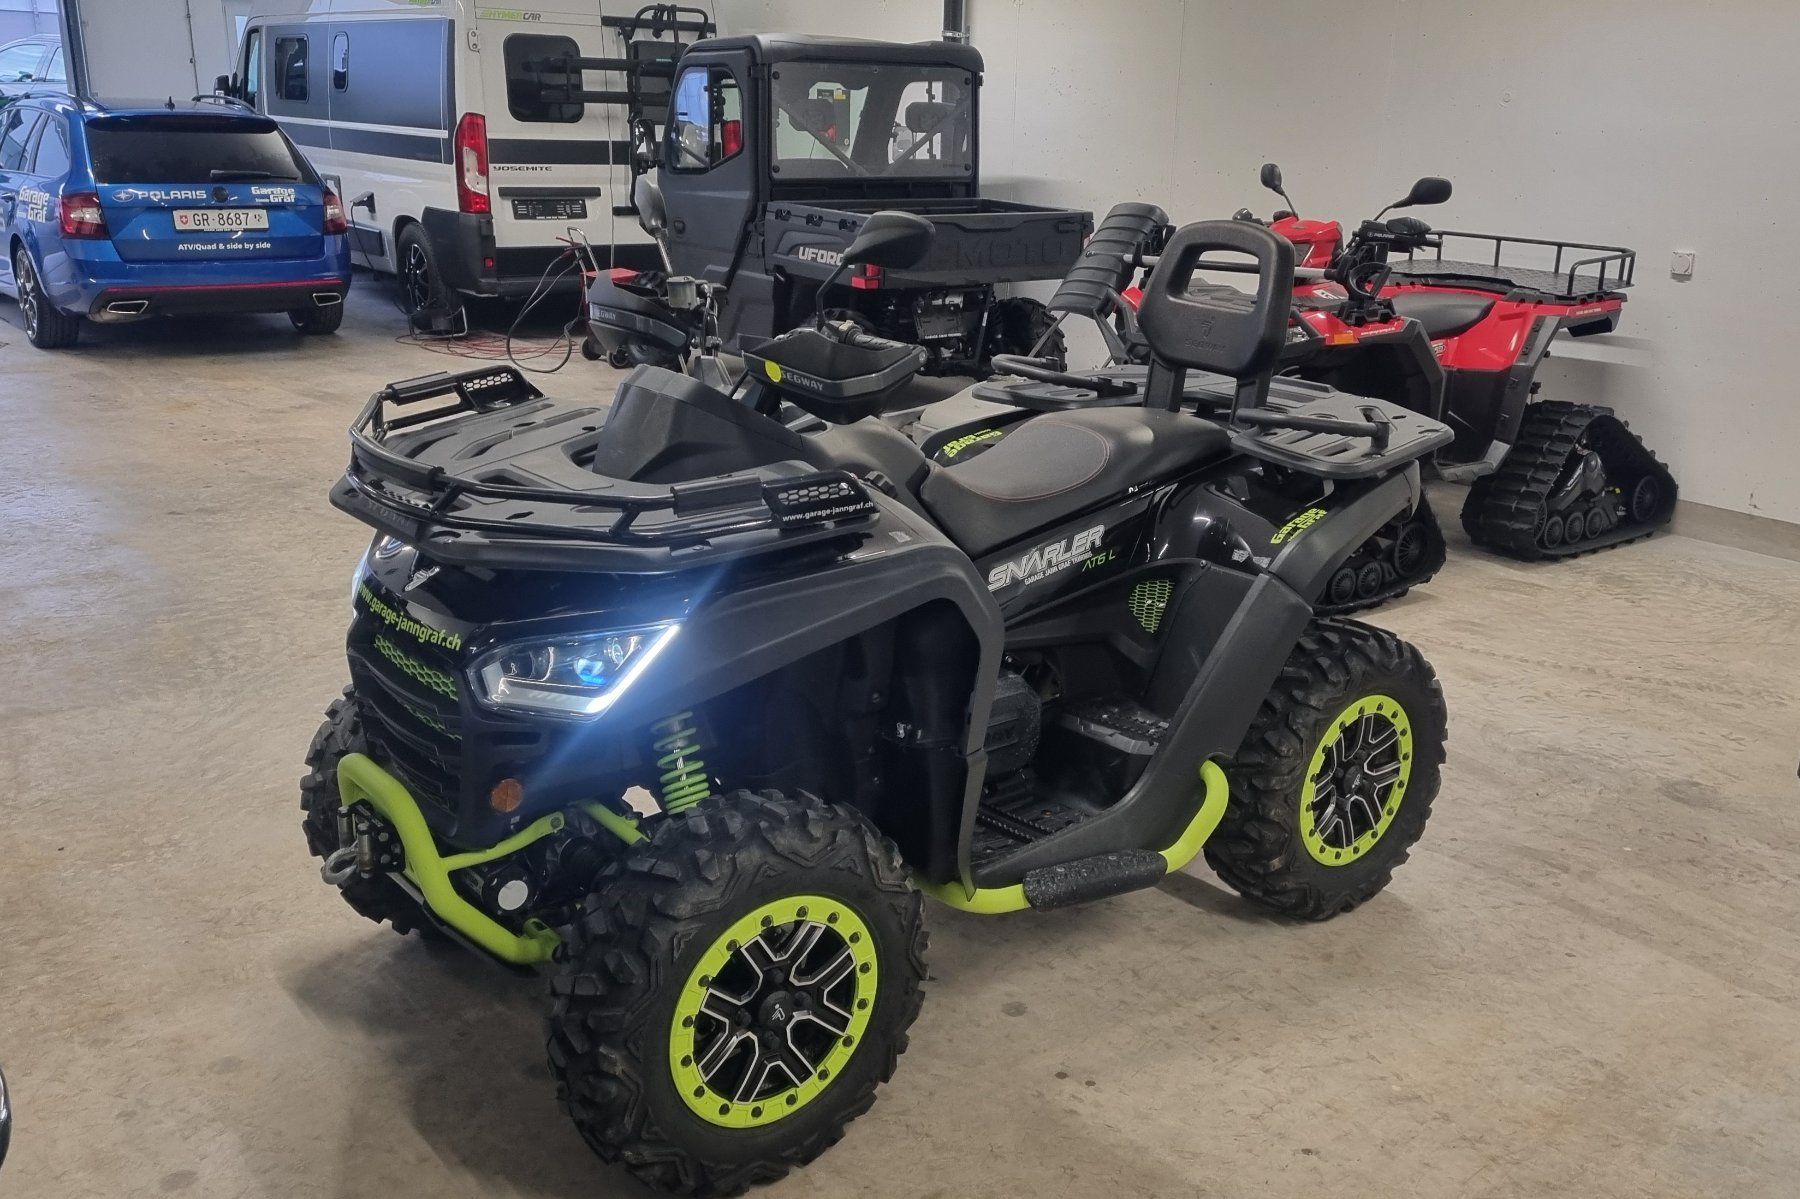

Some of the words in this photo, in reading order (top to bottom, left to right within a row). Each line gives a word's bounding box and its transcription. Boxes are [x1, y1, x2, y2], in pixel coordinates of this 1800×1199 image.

[138, 190, 206, 199] POLARIS
[251, 186, 295, 196] Garage
[269, 194, 295, 202] Graf
[244, 242, 254, 250] by
[799, 247, 843, 266] UFORC
[782, 501, 874, 521] www.garage-janngraf.ch
[1270, 508, 1320, 543] Garage
[987, 524, 1105, 592] SNARLER
